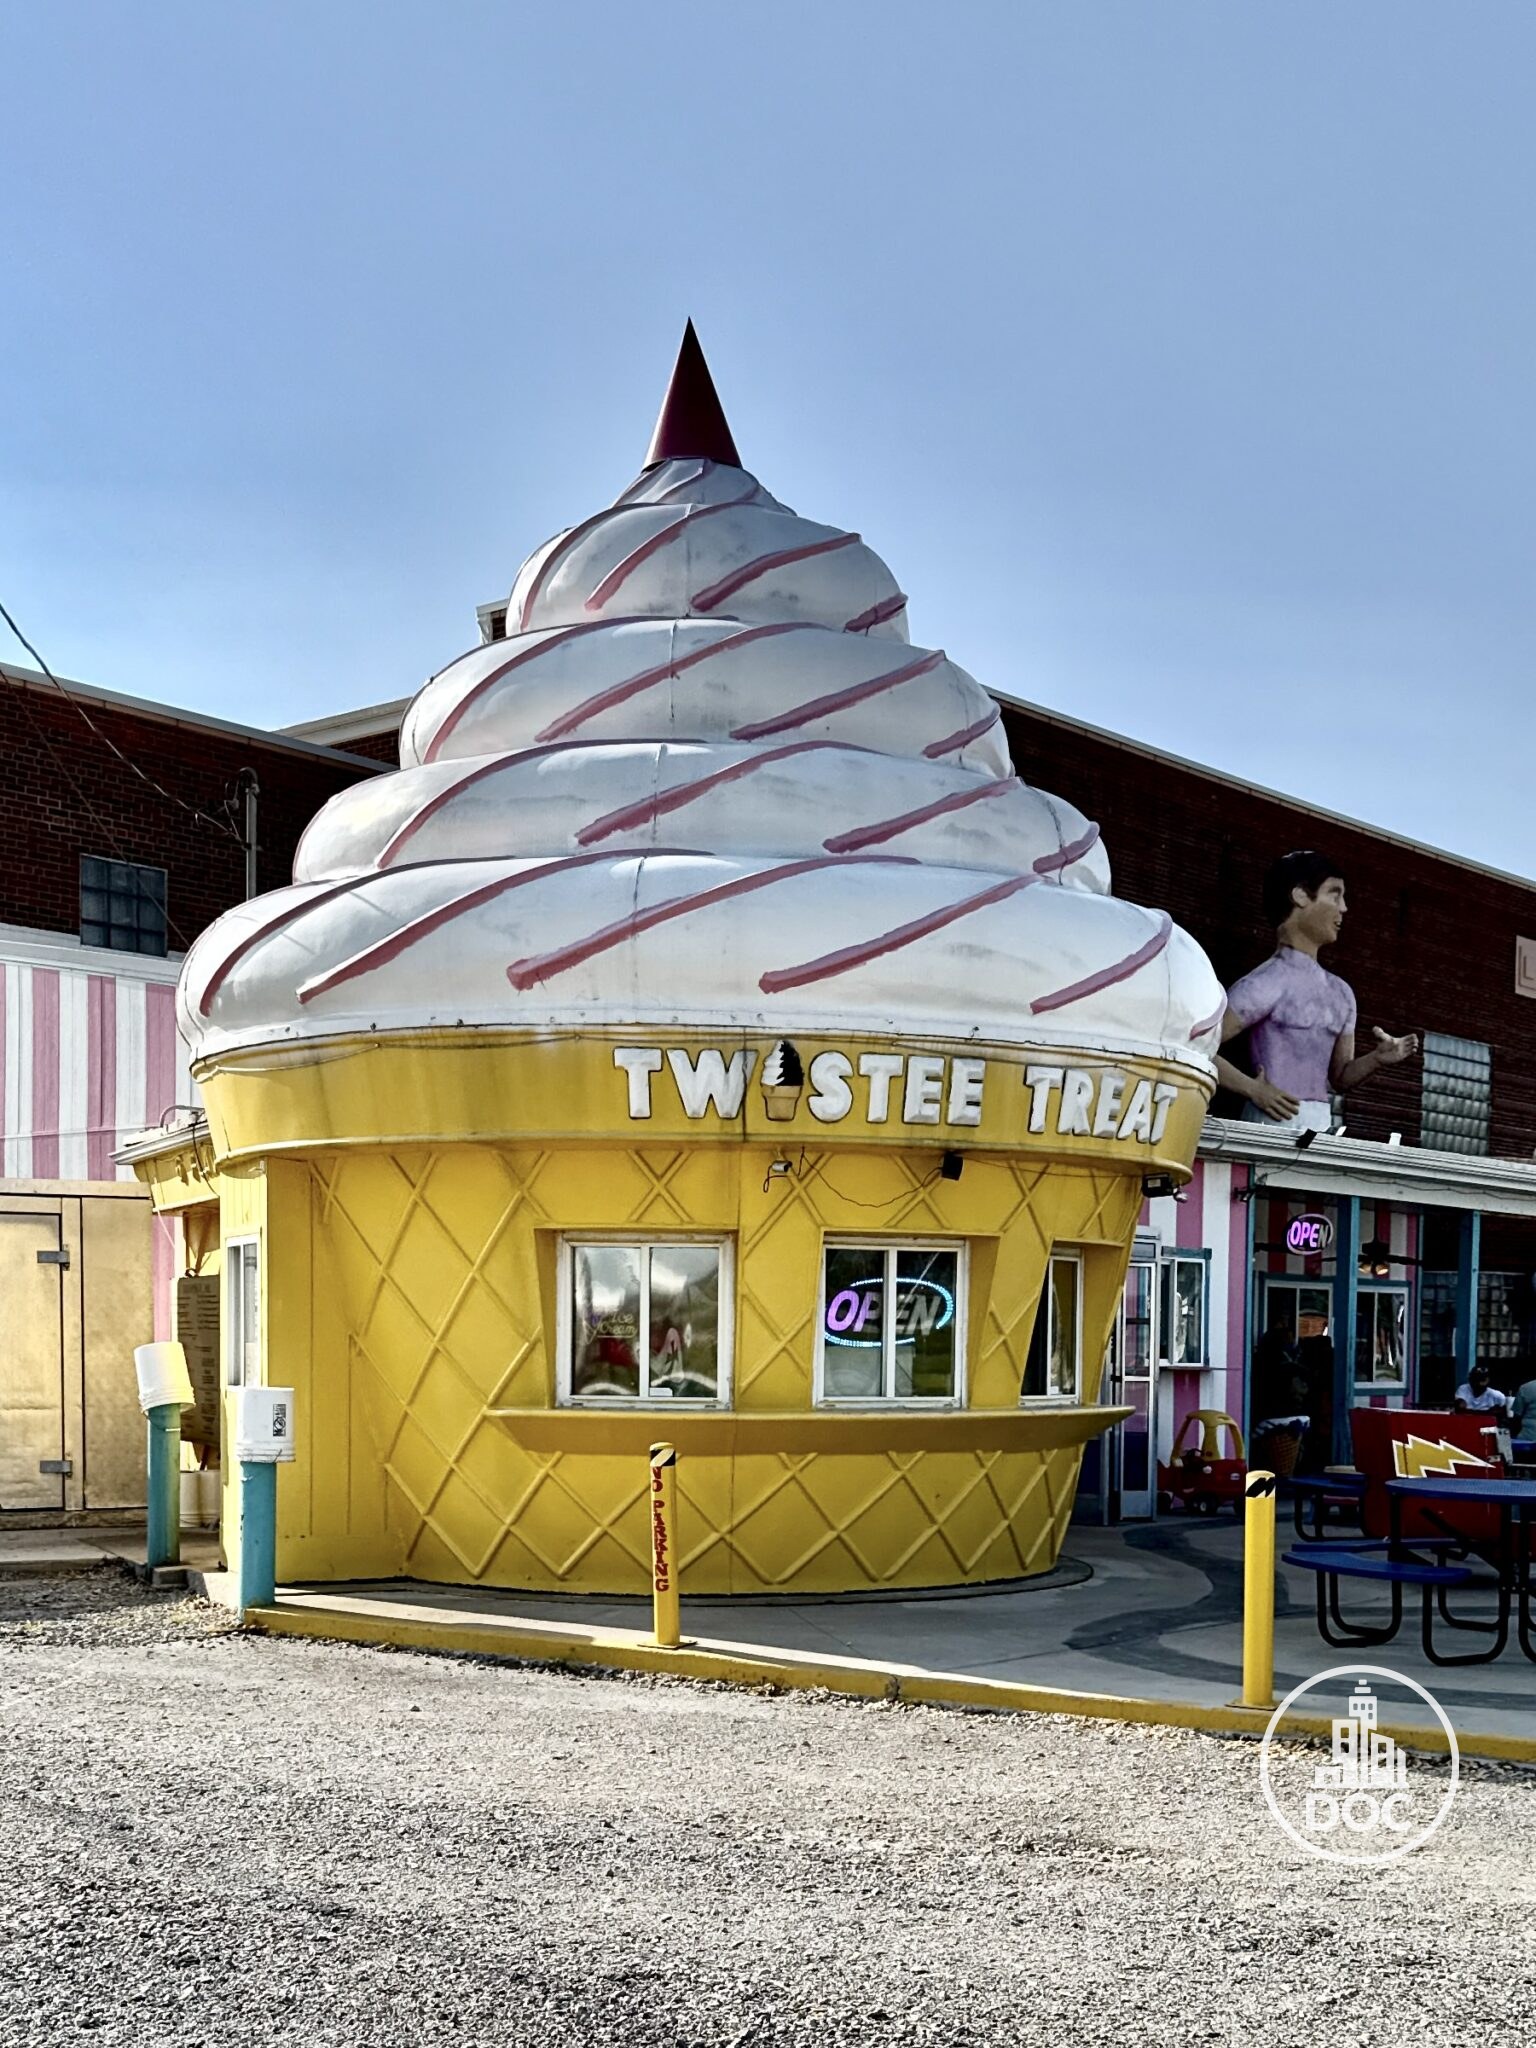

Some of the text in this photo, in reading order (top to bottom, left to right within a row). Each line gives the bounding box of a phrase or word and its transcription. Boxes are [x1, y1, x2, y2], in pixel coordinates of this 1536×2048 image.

[1024, 1065, 1177, 1144] TREAT
[1290, 1221, 1329, 1248] OPEN
[827, 1290, 942, 1335] OPEN
[653, 1466, 670, 1592] NO PARKING
